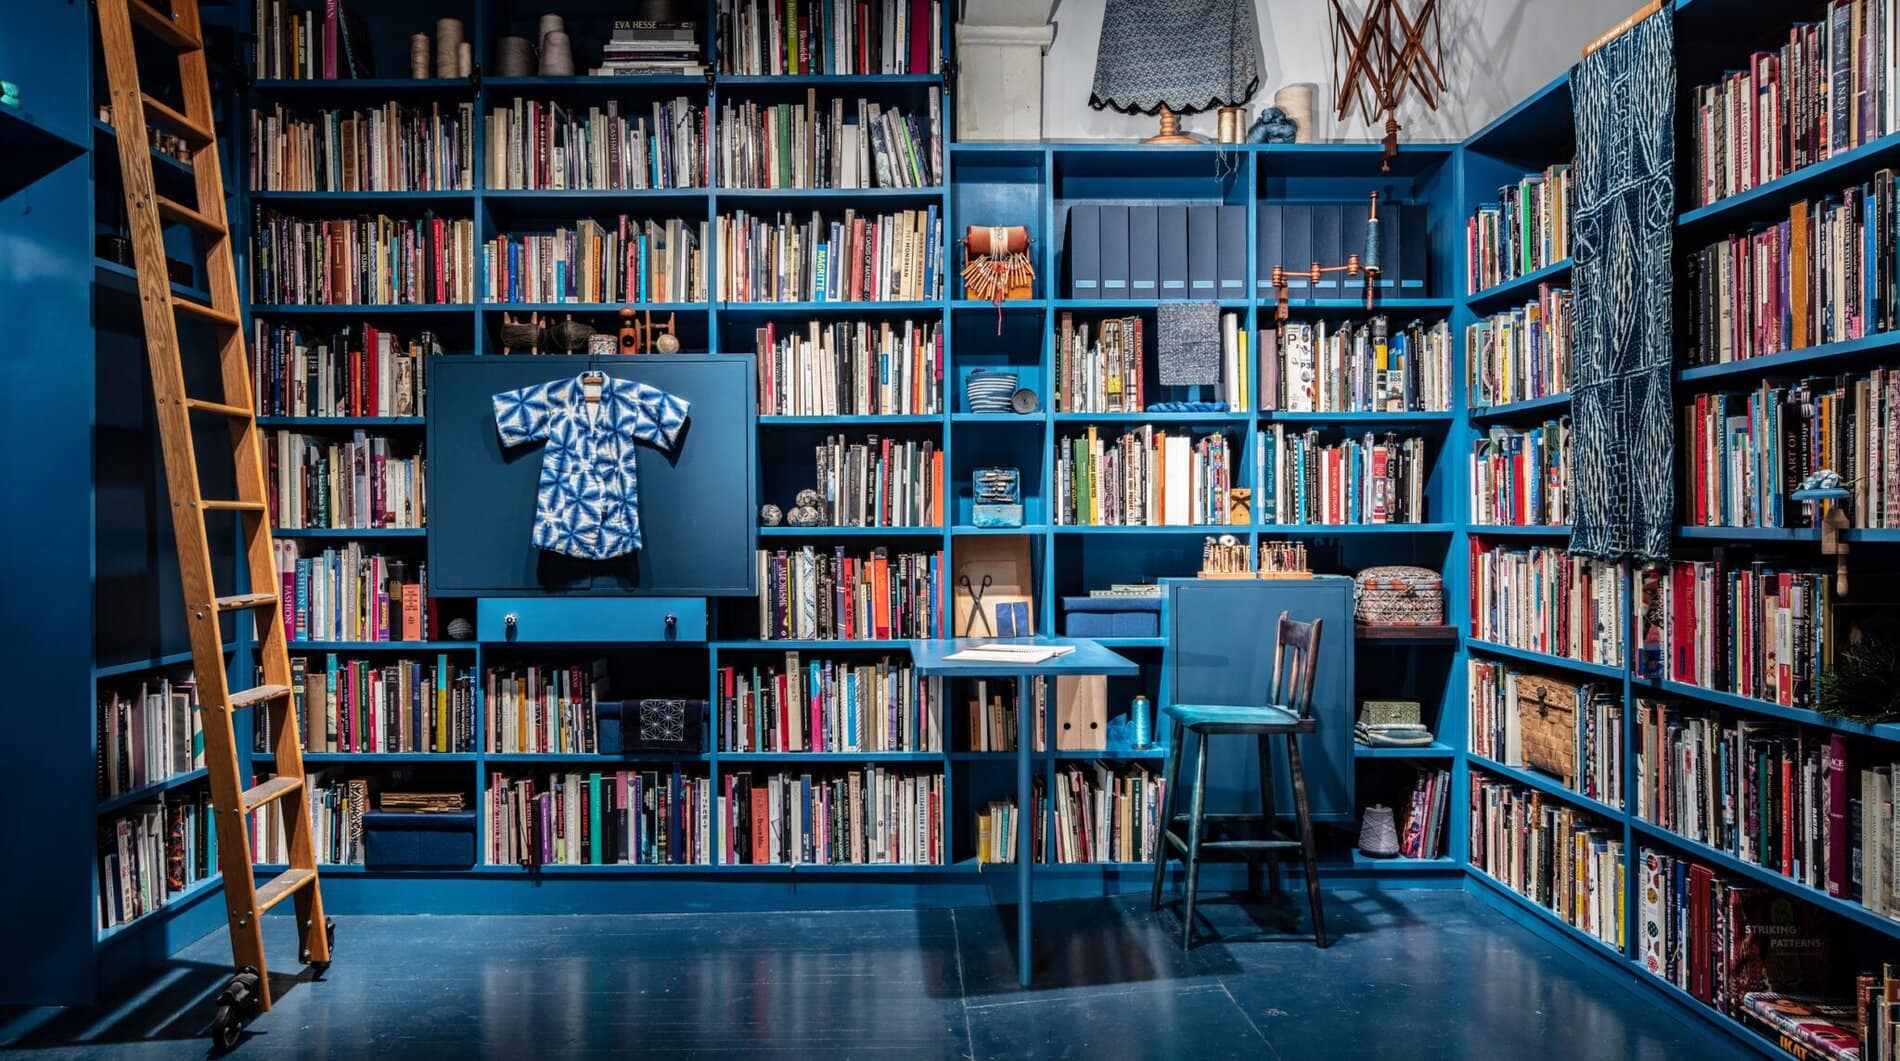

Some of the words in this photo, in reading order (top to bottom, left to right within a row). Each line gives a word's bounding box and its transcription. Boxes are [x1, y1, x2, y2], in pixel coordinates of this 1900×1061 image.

[615, 21, 631, 29] EVA
[633, 21, 656, 29] HESSE
[1837, 80, 1846, 120] INDIA
[816, 250, 827, 292] MAGRITTE
[903, 243, 911, 278] MONDRIAN
[1788, 432, 1797, 448] OF
[1802, 422, 1810, 452] african
[1788, 450, 1797, 472] ART
[779, 565, 787, 607] JAPONISME
[285, 585, 293, 624] FASHION
[1745, 925, 1797, 936] STRIKING
[1770, 938, 1824, 949] PATTERNS
[1779, 1034, 1808, 1060] IKAT
